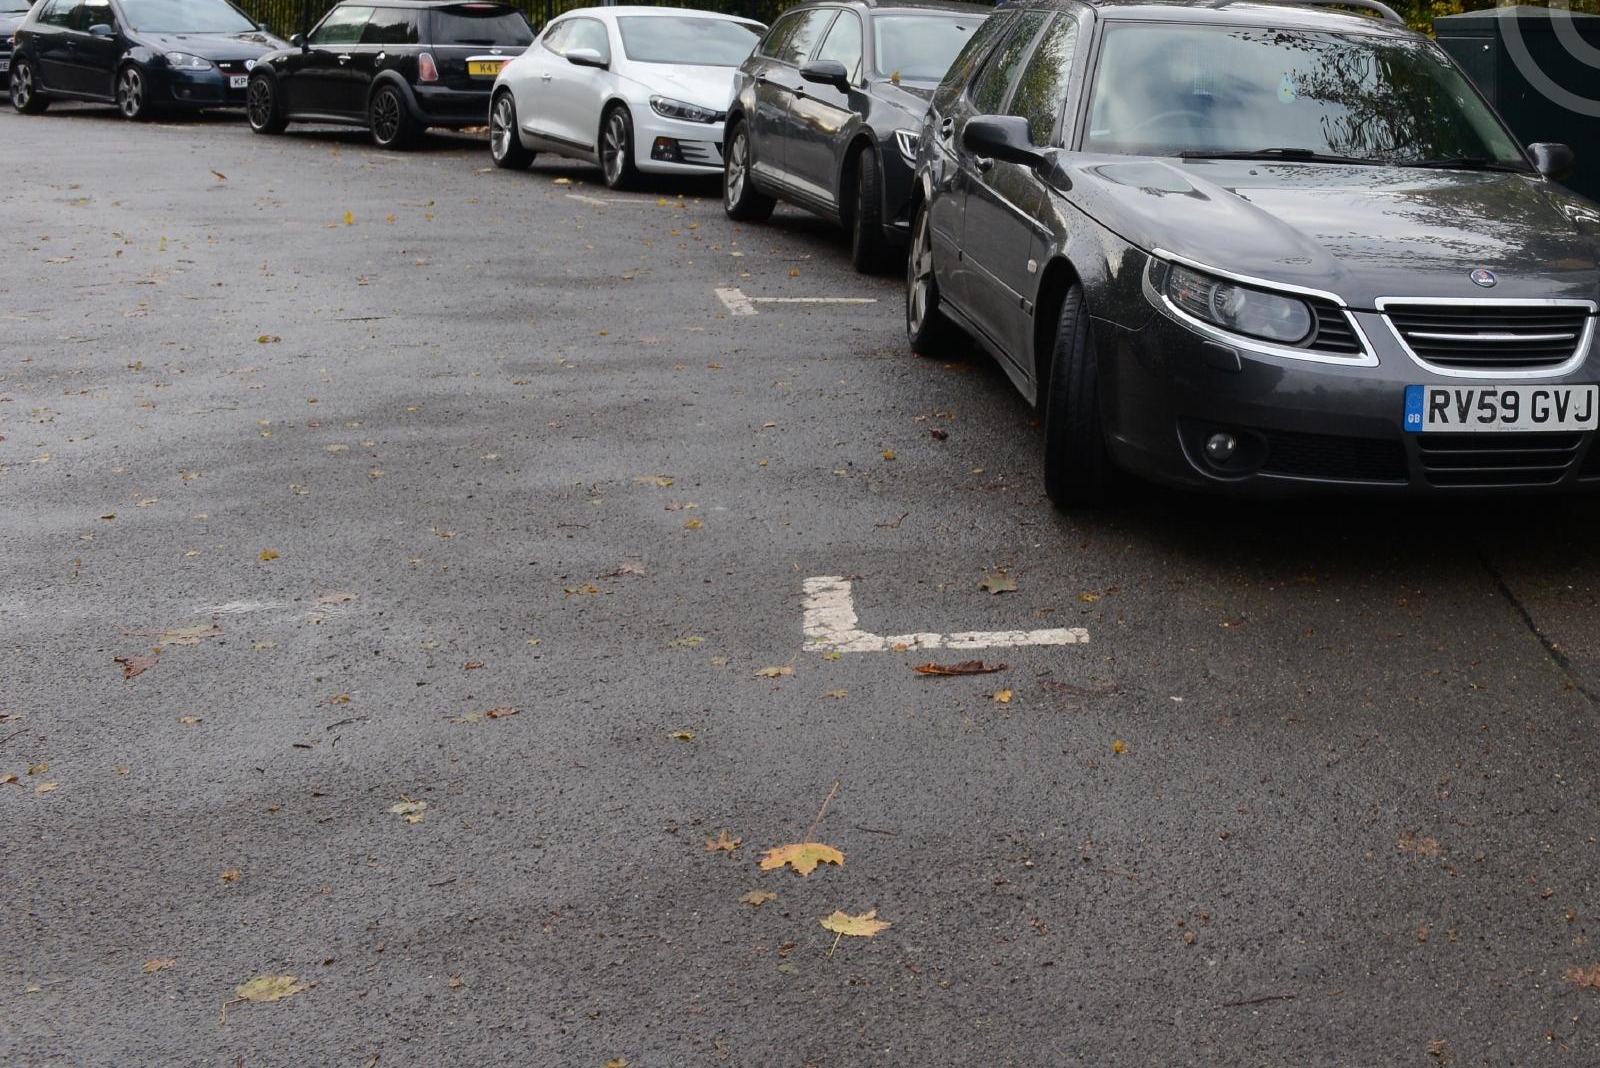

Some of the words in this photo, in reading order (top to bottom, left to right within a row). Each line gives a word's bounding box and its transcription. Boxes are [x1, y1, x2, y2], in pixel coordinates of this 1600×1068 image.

[1428, 390, 1520, 424] RV59
[1531, 390, 1592, 423] GVJ
[1408, 414, 1420, 424] GB
